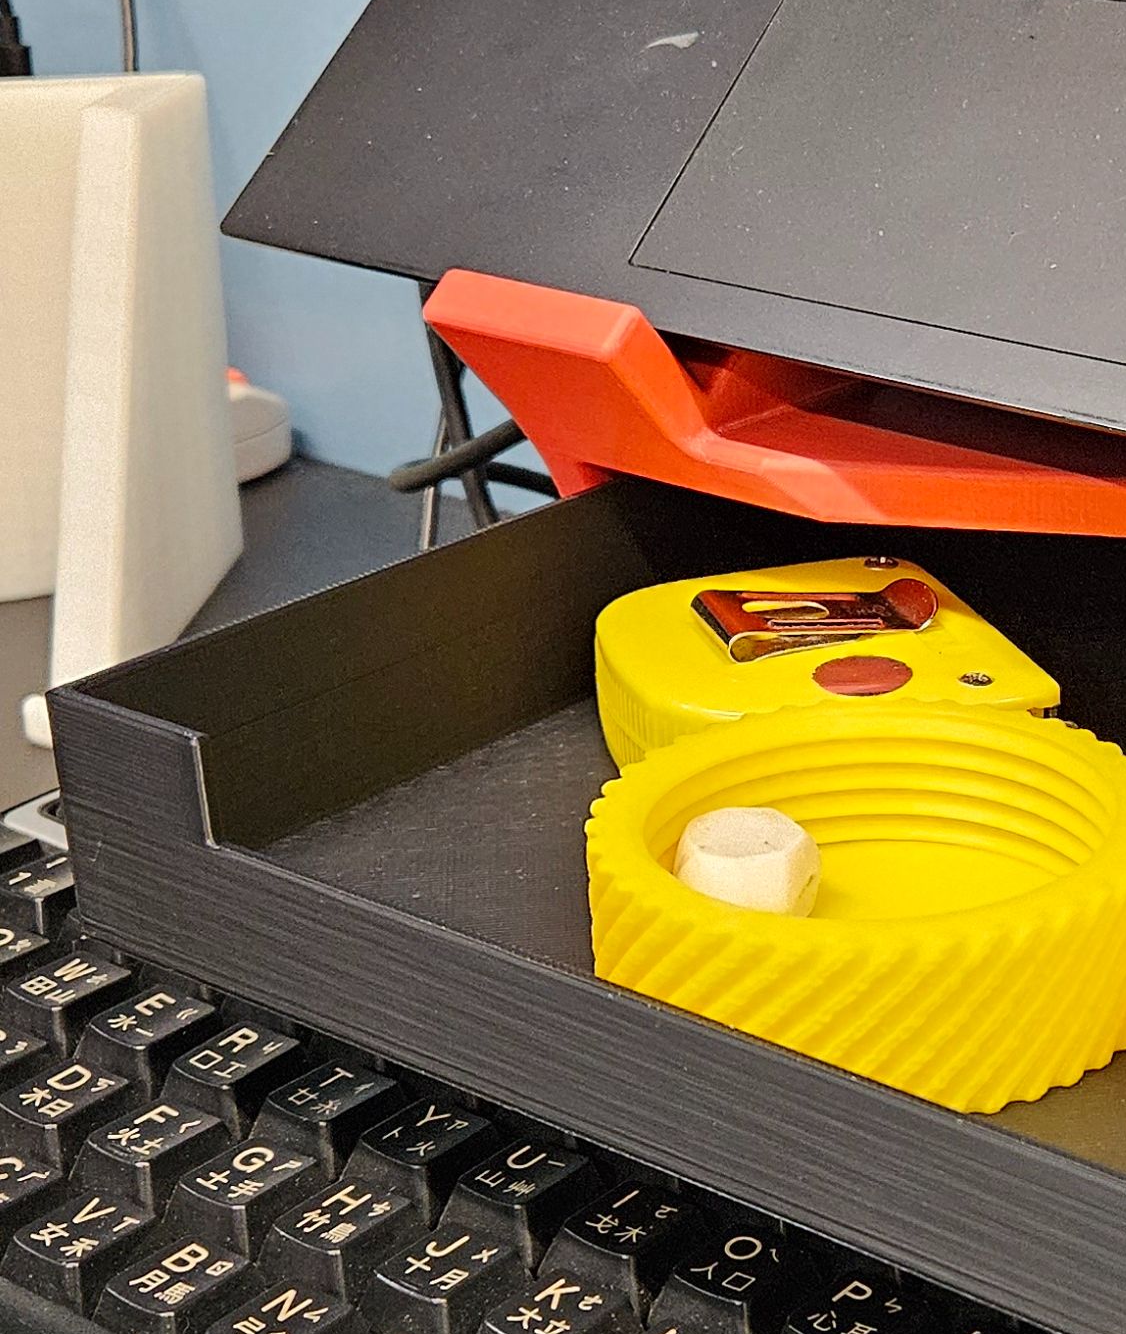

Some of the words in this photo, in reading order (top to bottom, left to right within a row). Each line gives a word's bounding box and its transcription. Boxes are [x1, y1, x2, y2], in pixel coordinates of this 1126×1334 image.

[52, 958, 99, 984] W
[134, 992, 177, 1016] E
[218, 1027, 259, 1053] R
[44, 1064, 94, 1094] D
[319, 1067, 354, 1088] T
[133, 1104, 180, 1125] F
[415, 1105, 454, 1130] Y
[232, 1146, 277, 1174] G
[506, 1145, 547, 1169] U
[72, 1197, 117, 1224] V
[319, 1185, 374, 1218] H
[159, 1243, 211, 1275] B
[422, 1235, 470, 1261] J
[724, 1236, 763, 1260] O
[532, 1278, 582, 1313] K
[831, 1280, 873, 1302] P
[260, 1289, 315, 1323] N
